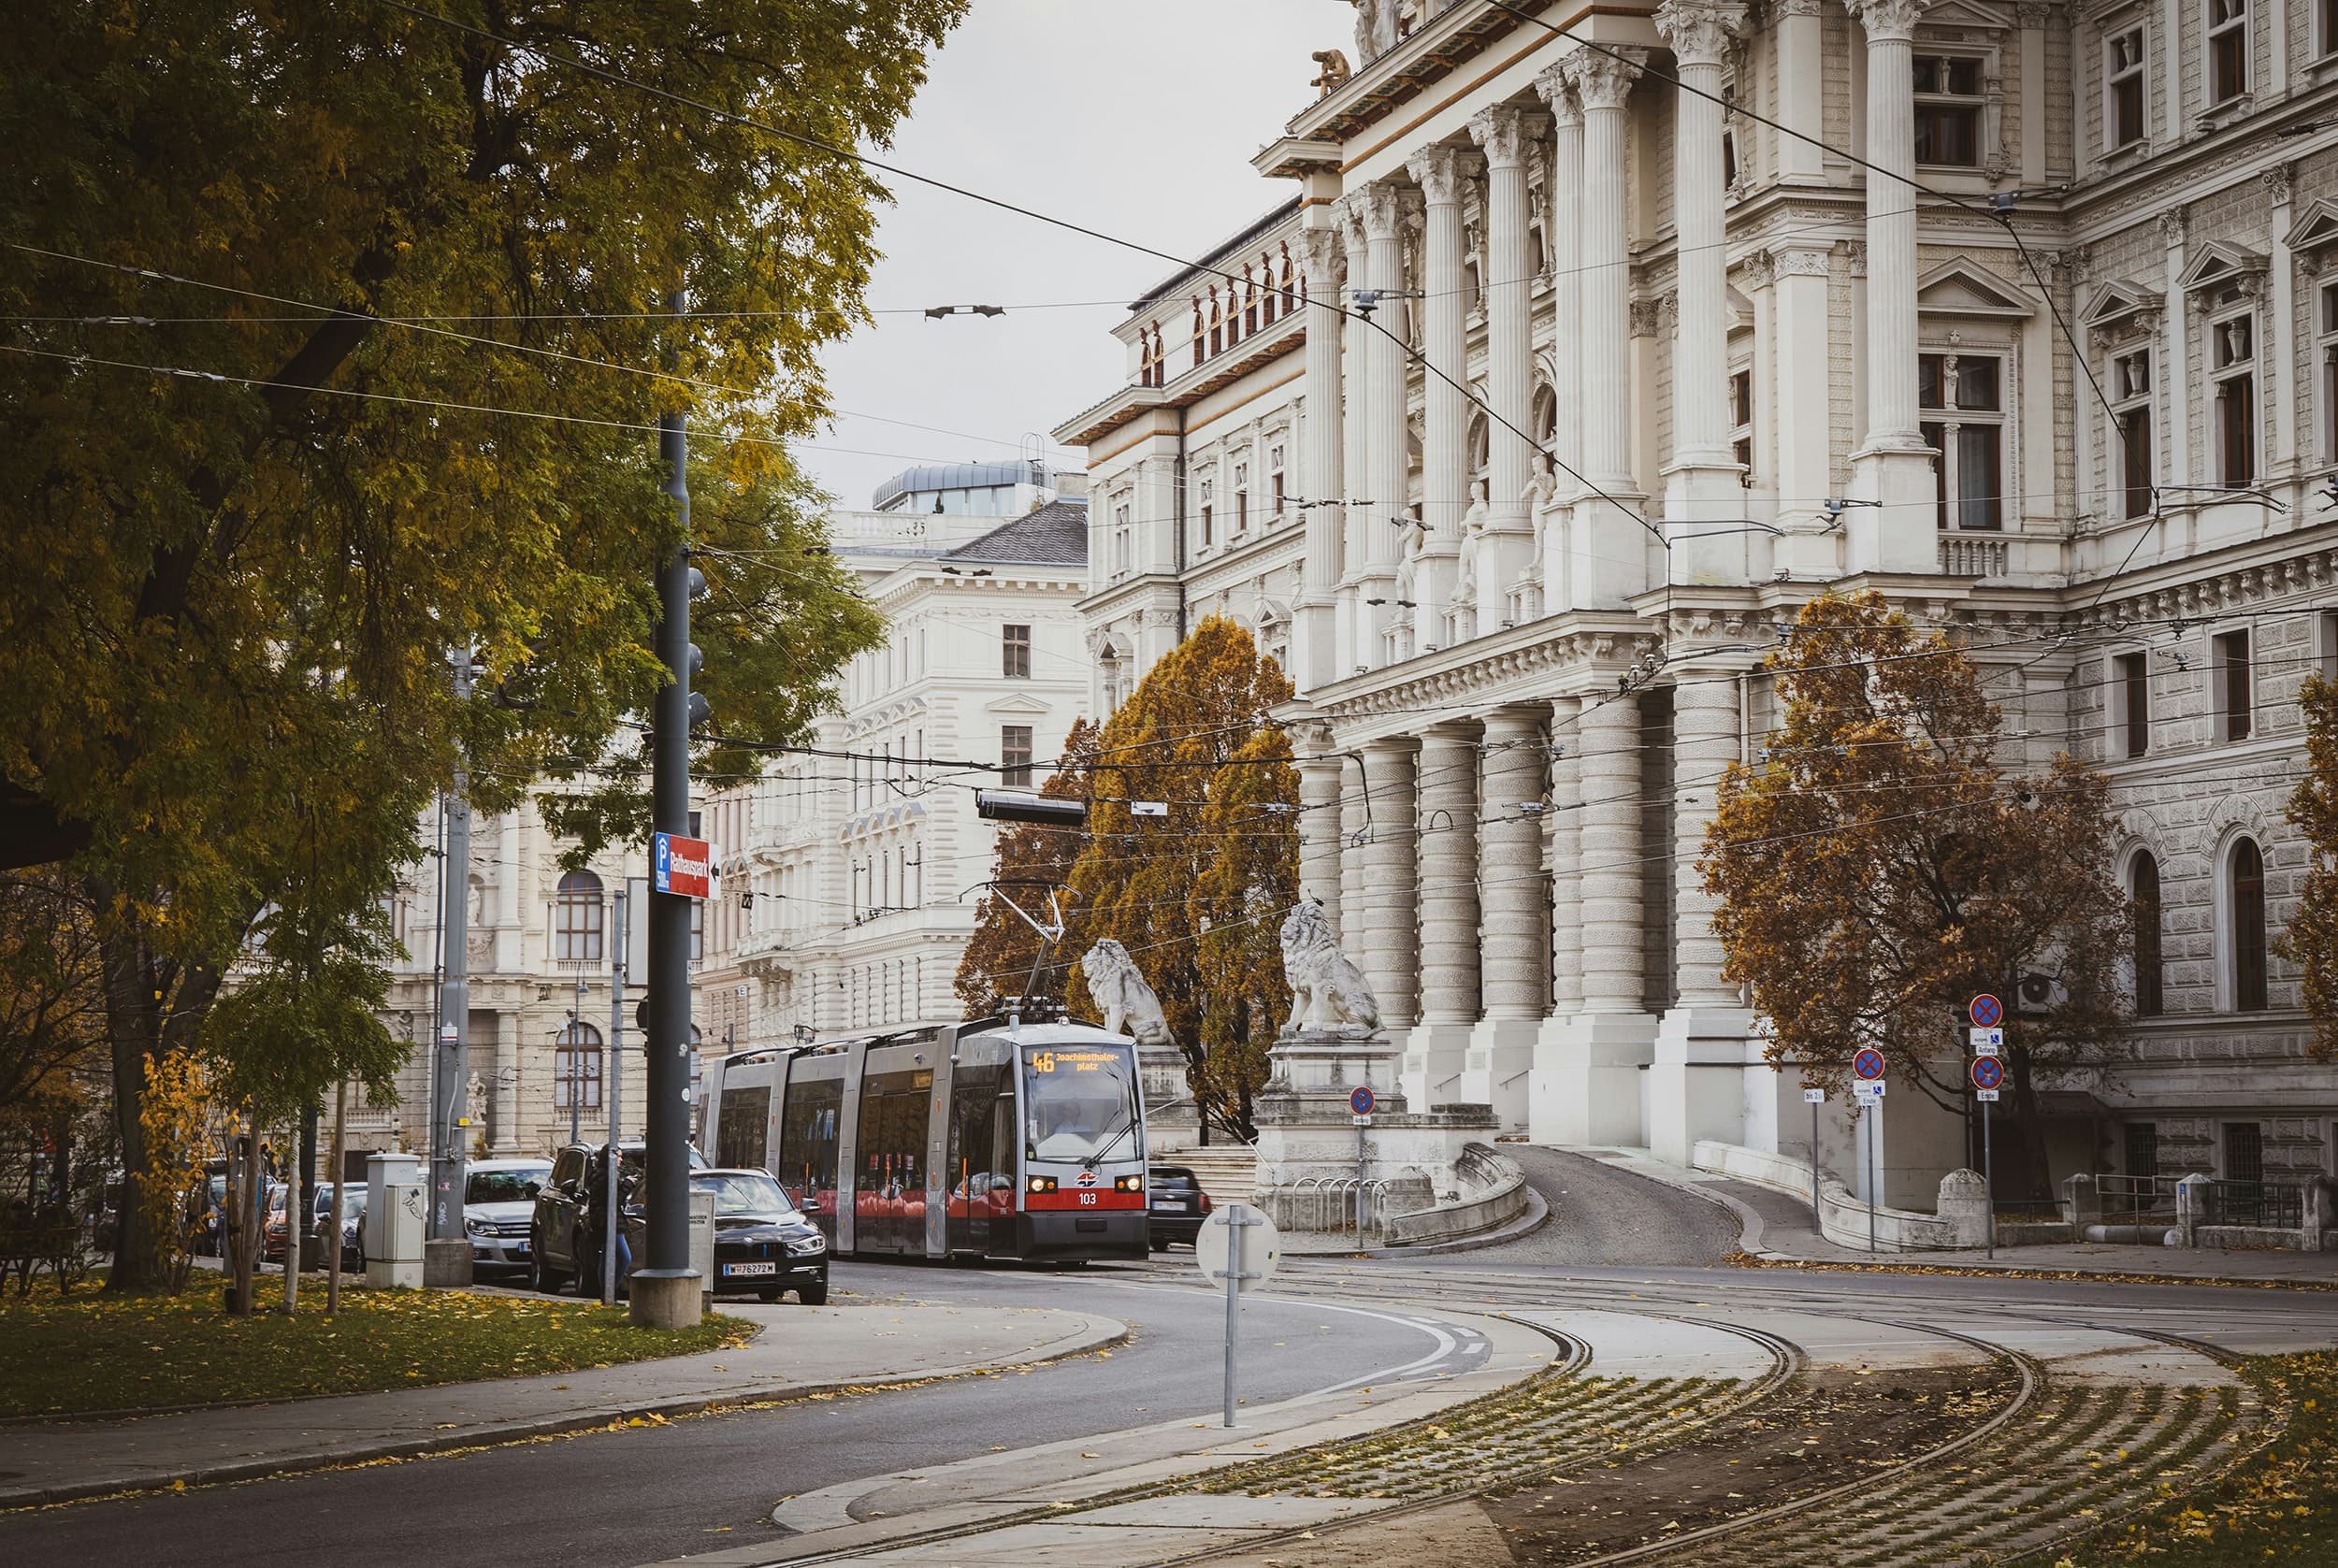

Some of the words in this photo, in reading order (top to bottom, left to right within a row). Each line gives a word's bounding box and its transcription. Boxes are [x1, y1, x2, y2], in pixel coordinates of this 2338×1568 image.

[659, 844, 667, 869] P
[670, 851, 709, 881] Rathauspark
[1978, 1046, 1997, 1055] Anfang
[1032, 1052, 1055, 1072] 46
[1076, 1062, 1099, 1072] platz
[1981, 1091, 1995, 1100] Ende
[1078, 1193, 1097, 1205] 103
